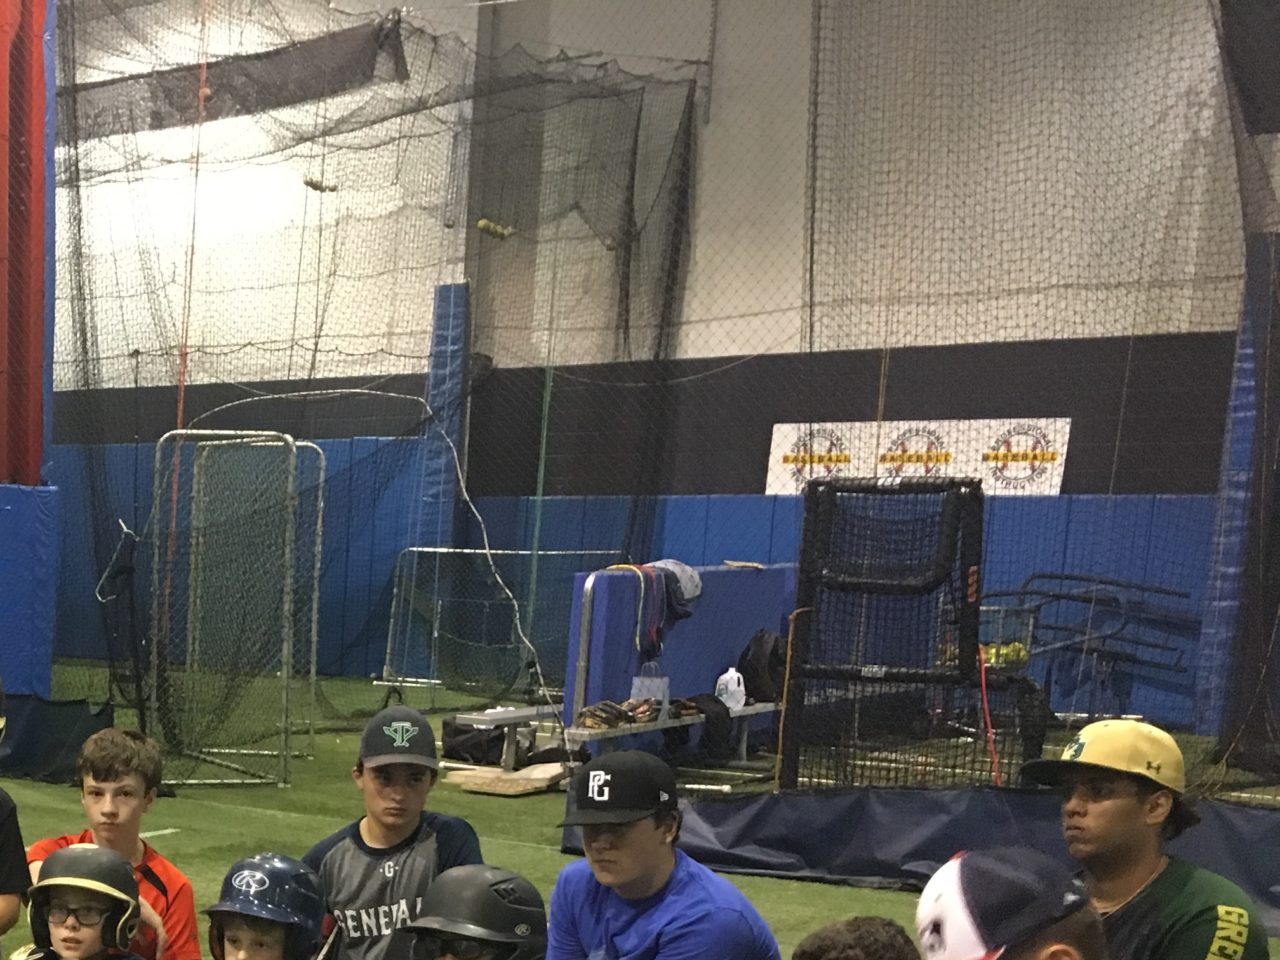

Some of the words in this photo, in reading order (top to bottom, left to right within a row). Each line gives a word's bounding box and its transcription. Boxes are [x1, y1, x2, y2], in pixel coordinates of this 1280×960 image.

[782, 453, 851, 465] BASEBALL
[880, 451, 951, 464] BASEBALL
[982, 450, 1058, 463] BASEBALL
